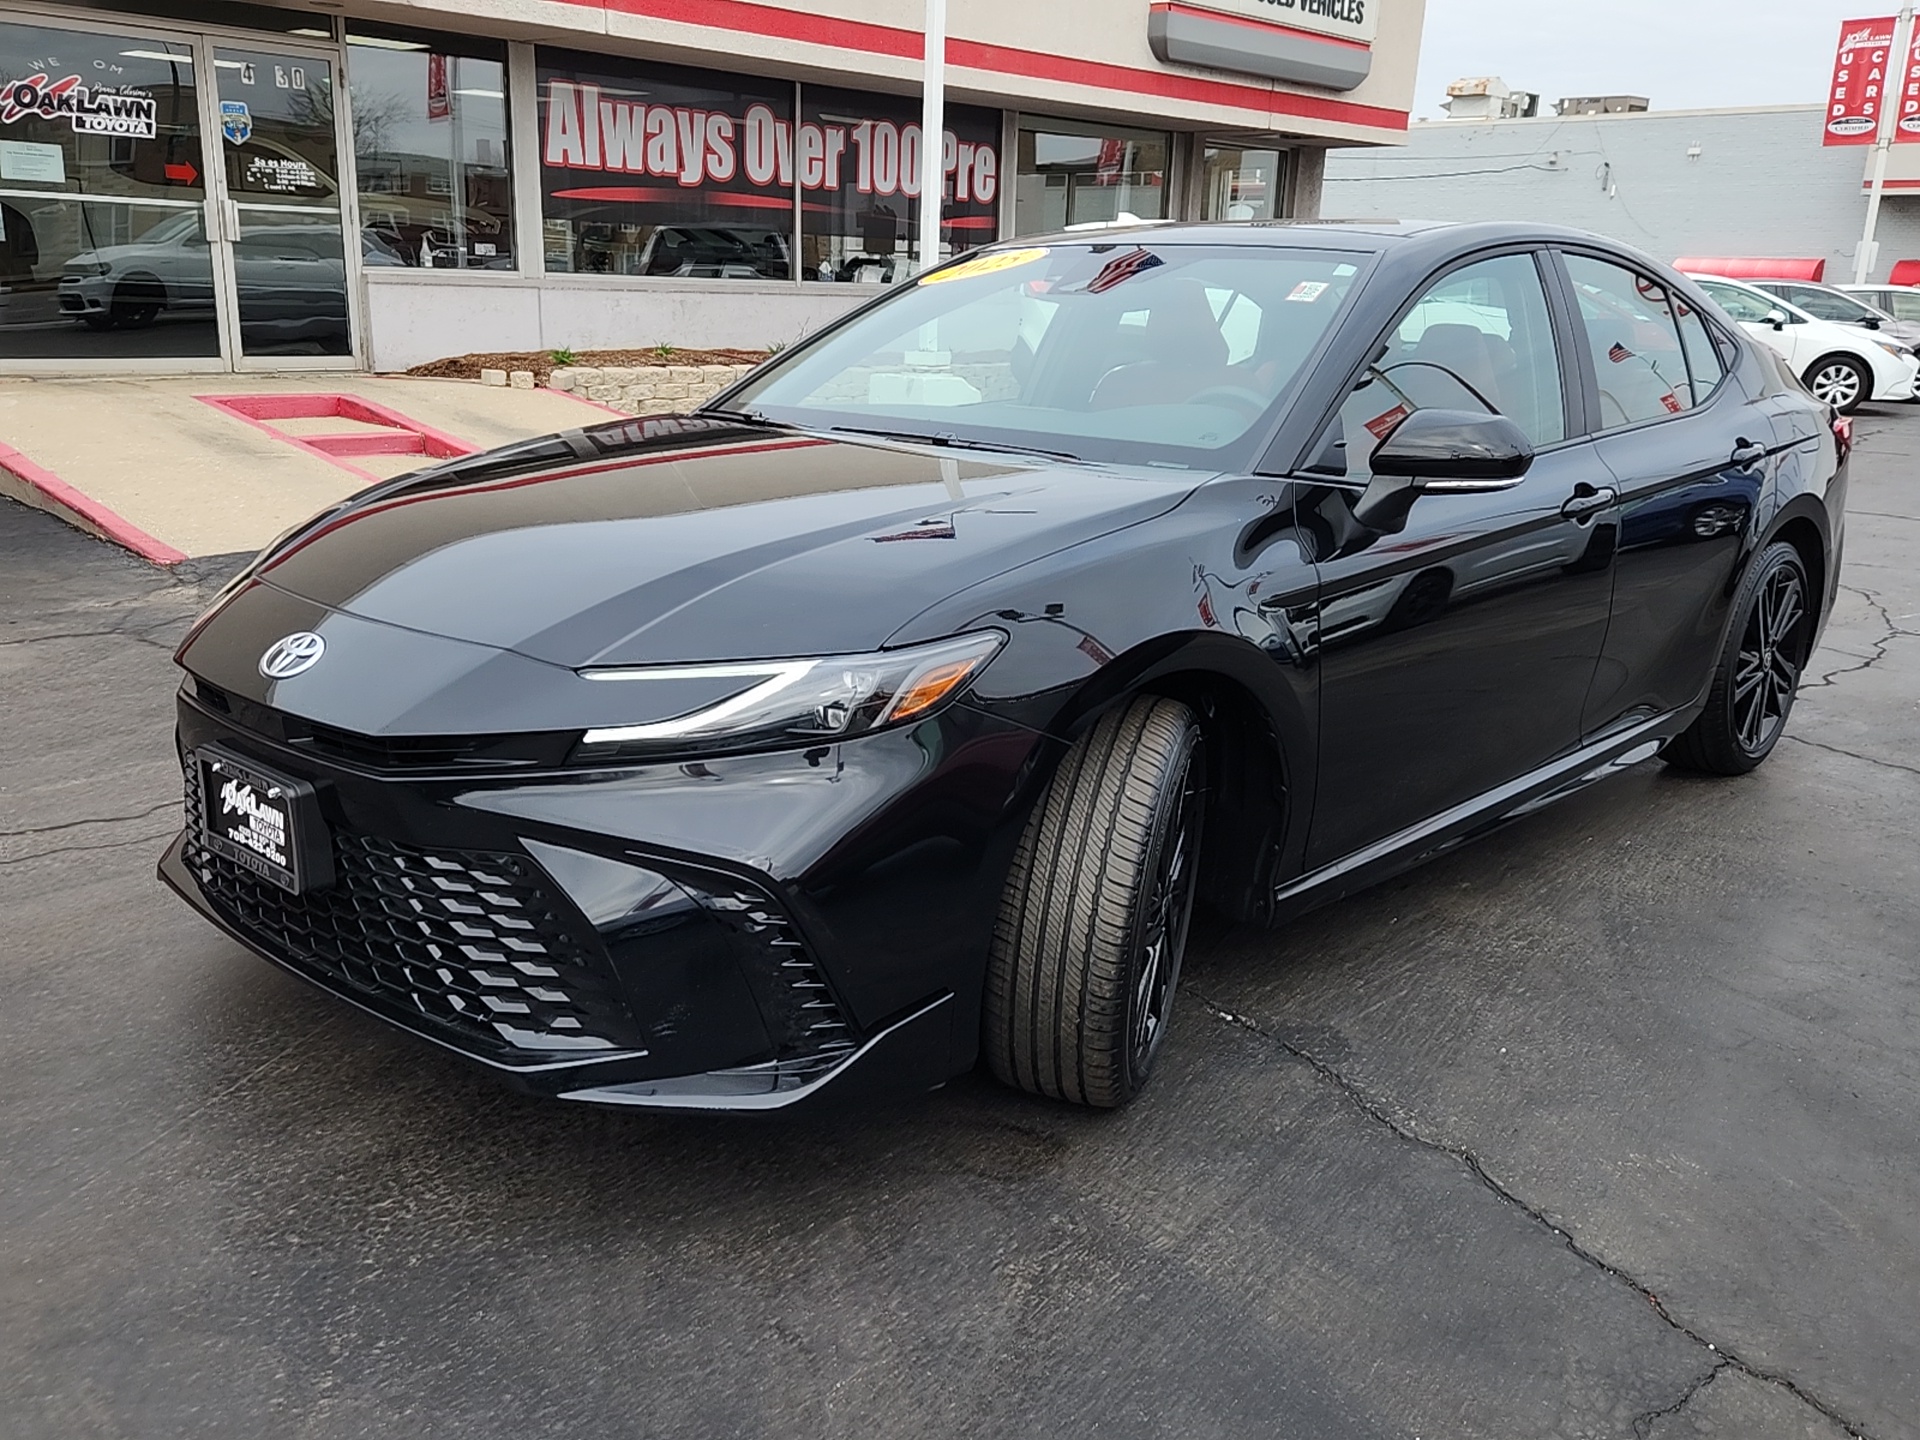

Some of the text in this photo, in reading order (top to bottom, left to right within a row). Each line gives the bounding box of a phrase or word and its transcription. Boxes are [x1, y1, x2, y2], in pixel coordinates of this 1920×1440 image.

[1832, 53, 1854, 116] USED
[1862, 50, 1884, 115] CARS
[83, 115, 149, 134] TOYOTA
[545, 78, 997, 204] Always Over 100 Pre
[253, 817, 282, 843] TOYOTA
[233, 847, 271, 878] TOYOTA
